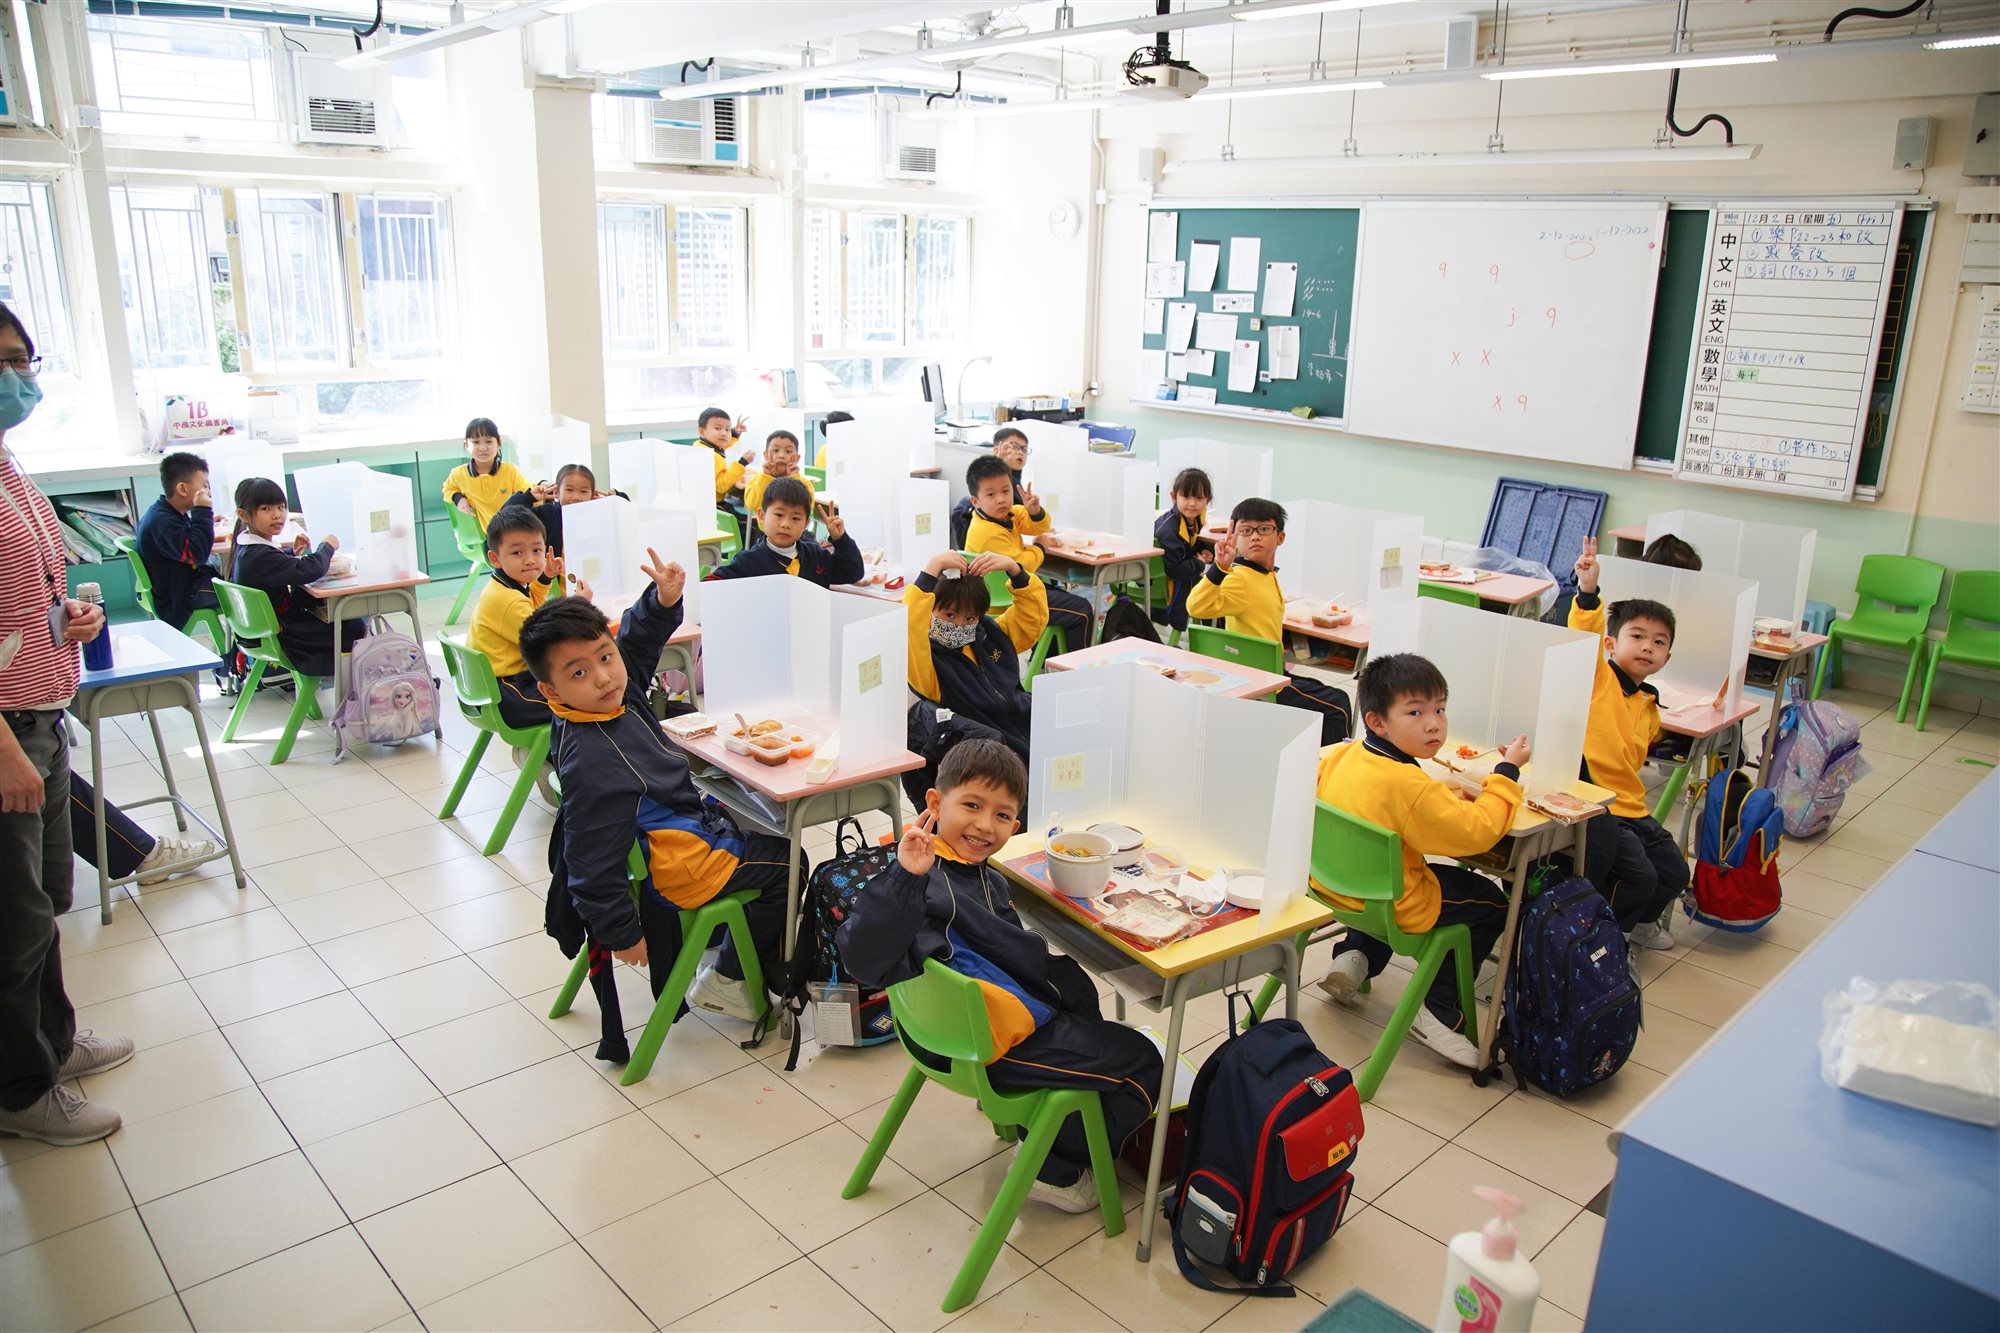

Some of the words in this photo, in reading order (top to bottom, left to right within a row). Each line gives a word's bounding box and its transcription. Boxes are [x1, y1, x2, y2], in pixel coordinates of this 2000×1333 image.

[1717, 232, 1737, 273] 中文
[1713, 279, 1732, 288] CHI
[1708, 299, 1728, 334] 英文
[1705, 335, 1724, 345] ENG
[1700, 348, 1721, 382] 數學
[1695, 384, 1719, 393] MATH
[187, 401, 208, 419] 1B
[1693, 401, 1714, 412] 常識
[1695, 416, 1709, 424] GS
[1688, 433, 1710, 445] 其他
[1685, 447, 1710, 457] OTHERS
